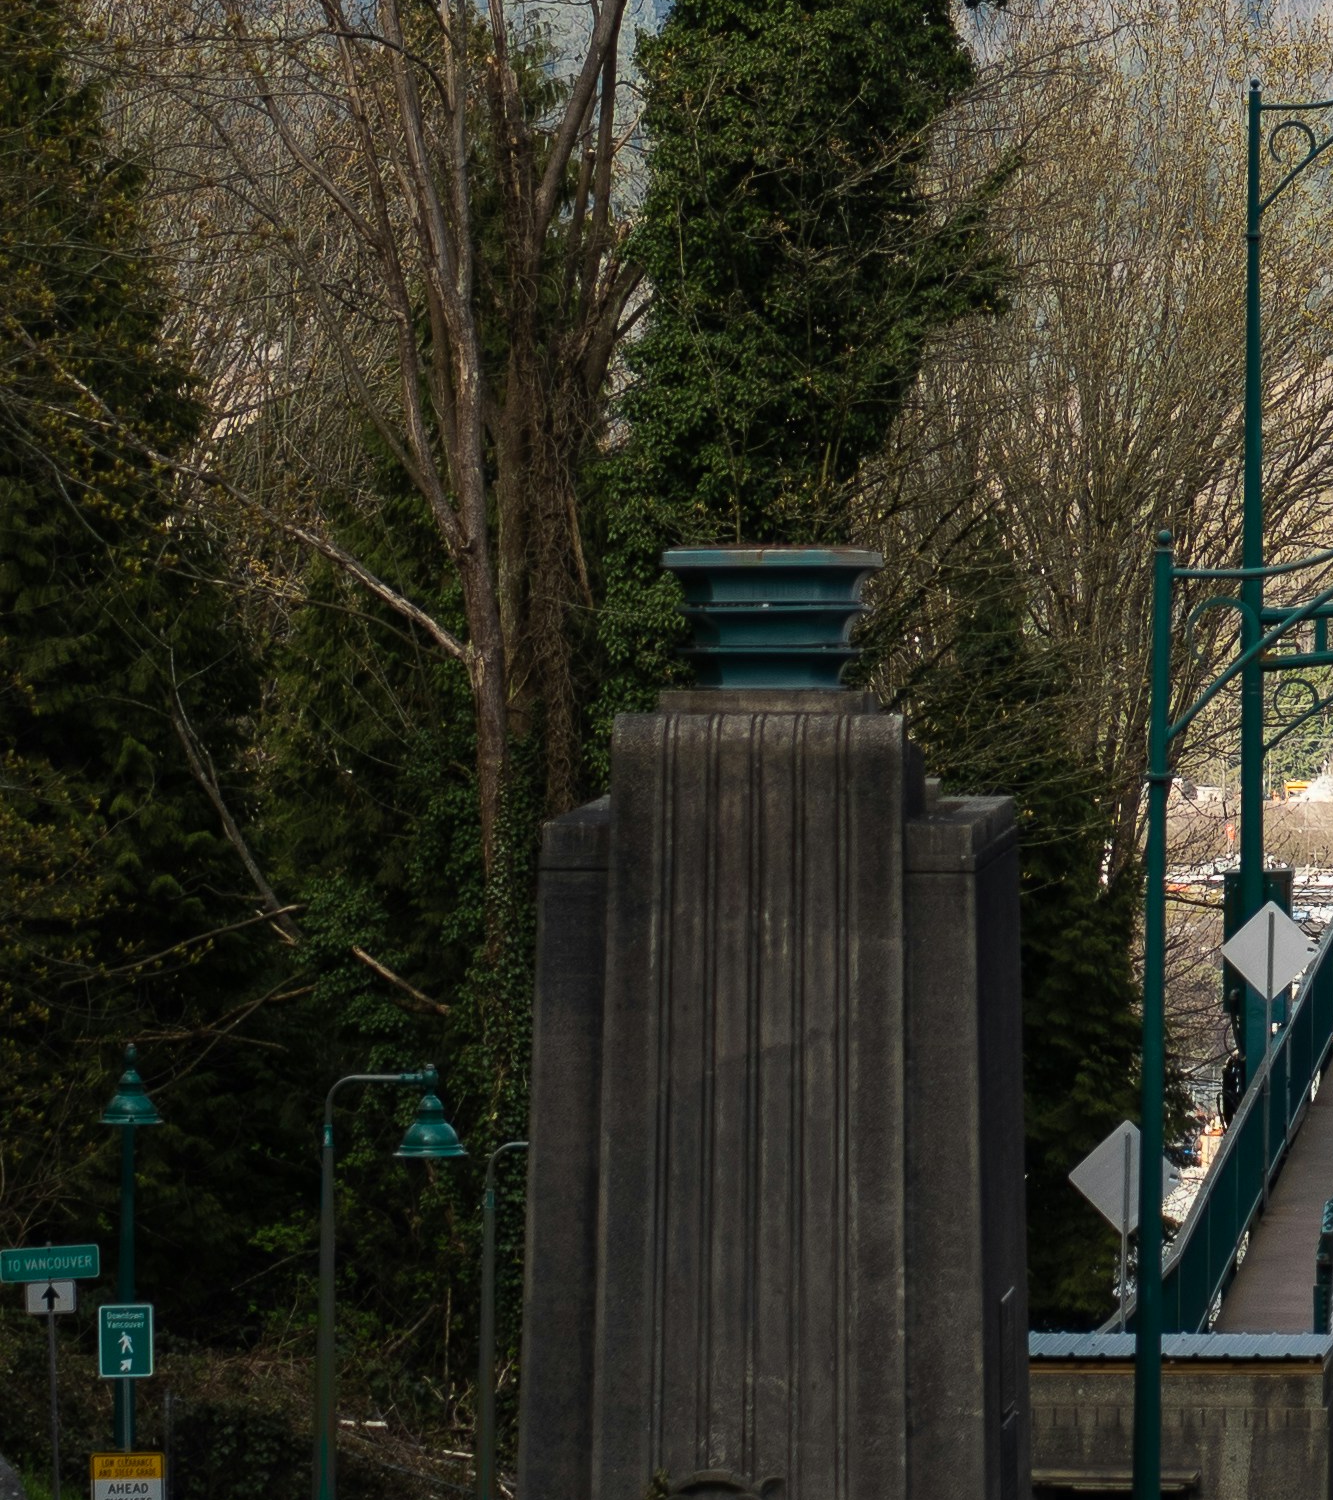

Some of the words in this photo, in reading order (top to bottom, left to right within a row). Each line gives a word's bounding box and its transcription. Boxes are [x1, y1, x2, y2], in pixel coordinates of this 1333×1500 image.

[8, 1260, 21, 1273] TO
[24, 1255, 93, 1271] VANCOUVER
[106, 1311, 145, 1321] Downtown
[106, 1321, 145, 1329] Vancouver
[107, 1483, 149, 1495] AHEAD
